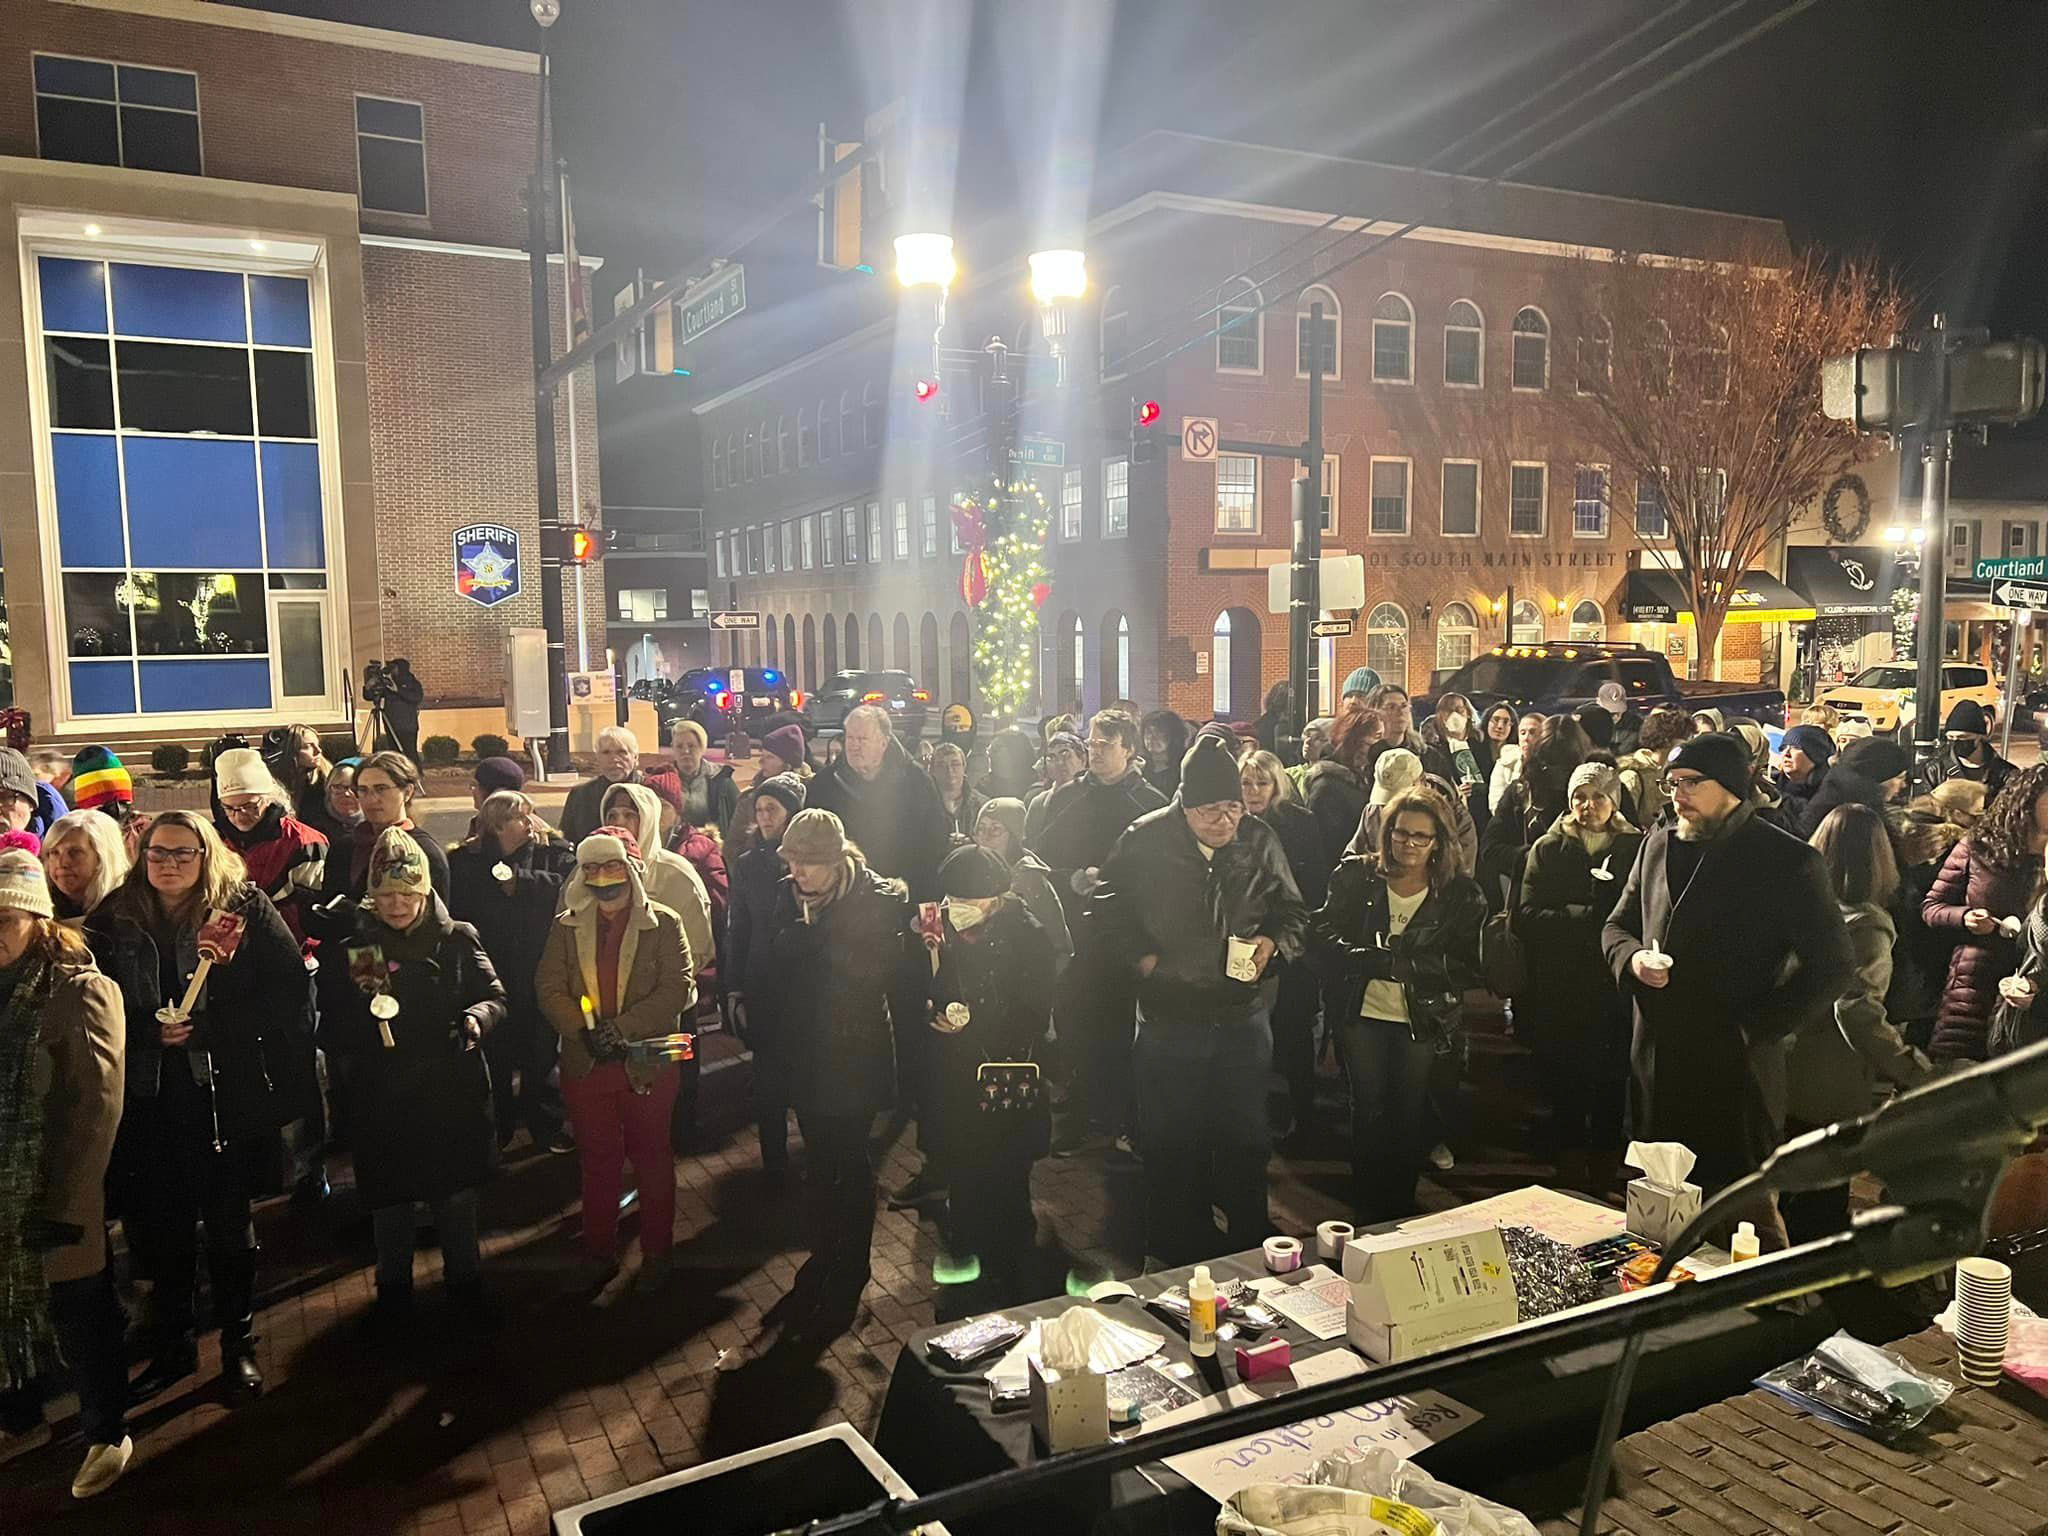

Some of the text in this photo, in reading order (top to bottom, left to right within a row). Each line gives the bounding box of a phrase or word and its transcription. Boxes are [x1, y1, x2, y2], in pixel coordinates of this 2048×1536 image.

[687, 291, 724, 333] Courtland
[457, 527, 515, 546] SHERIFF
[1401, 552, 1472, 567] SOUTH
[1483, 552, 1532, 567] MAIN
[1542, 552, 1617, 567] STREET
[1976, 559, 2045, 578] Courtland
[2008, 588, 2045, 602] ONE WAY
[724, 616, 754, 625] ONE WAY
[1398, 912, 1409, 924] to
[1379, 1402, 1461, 1441] Rest in
